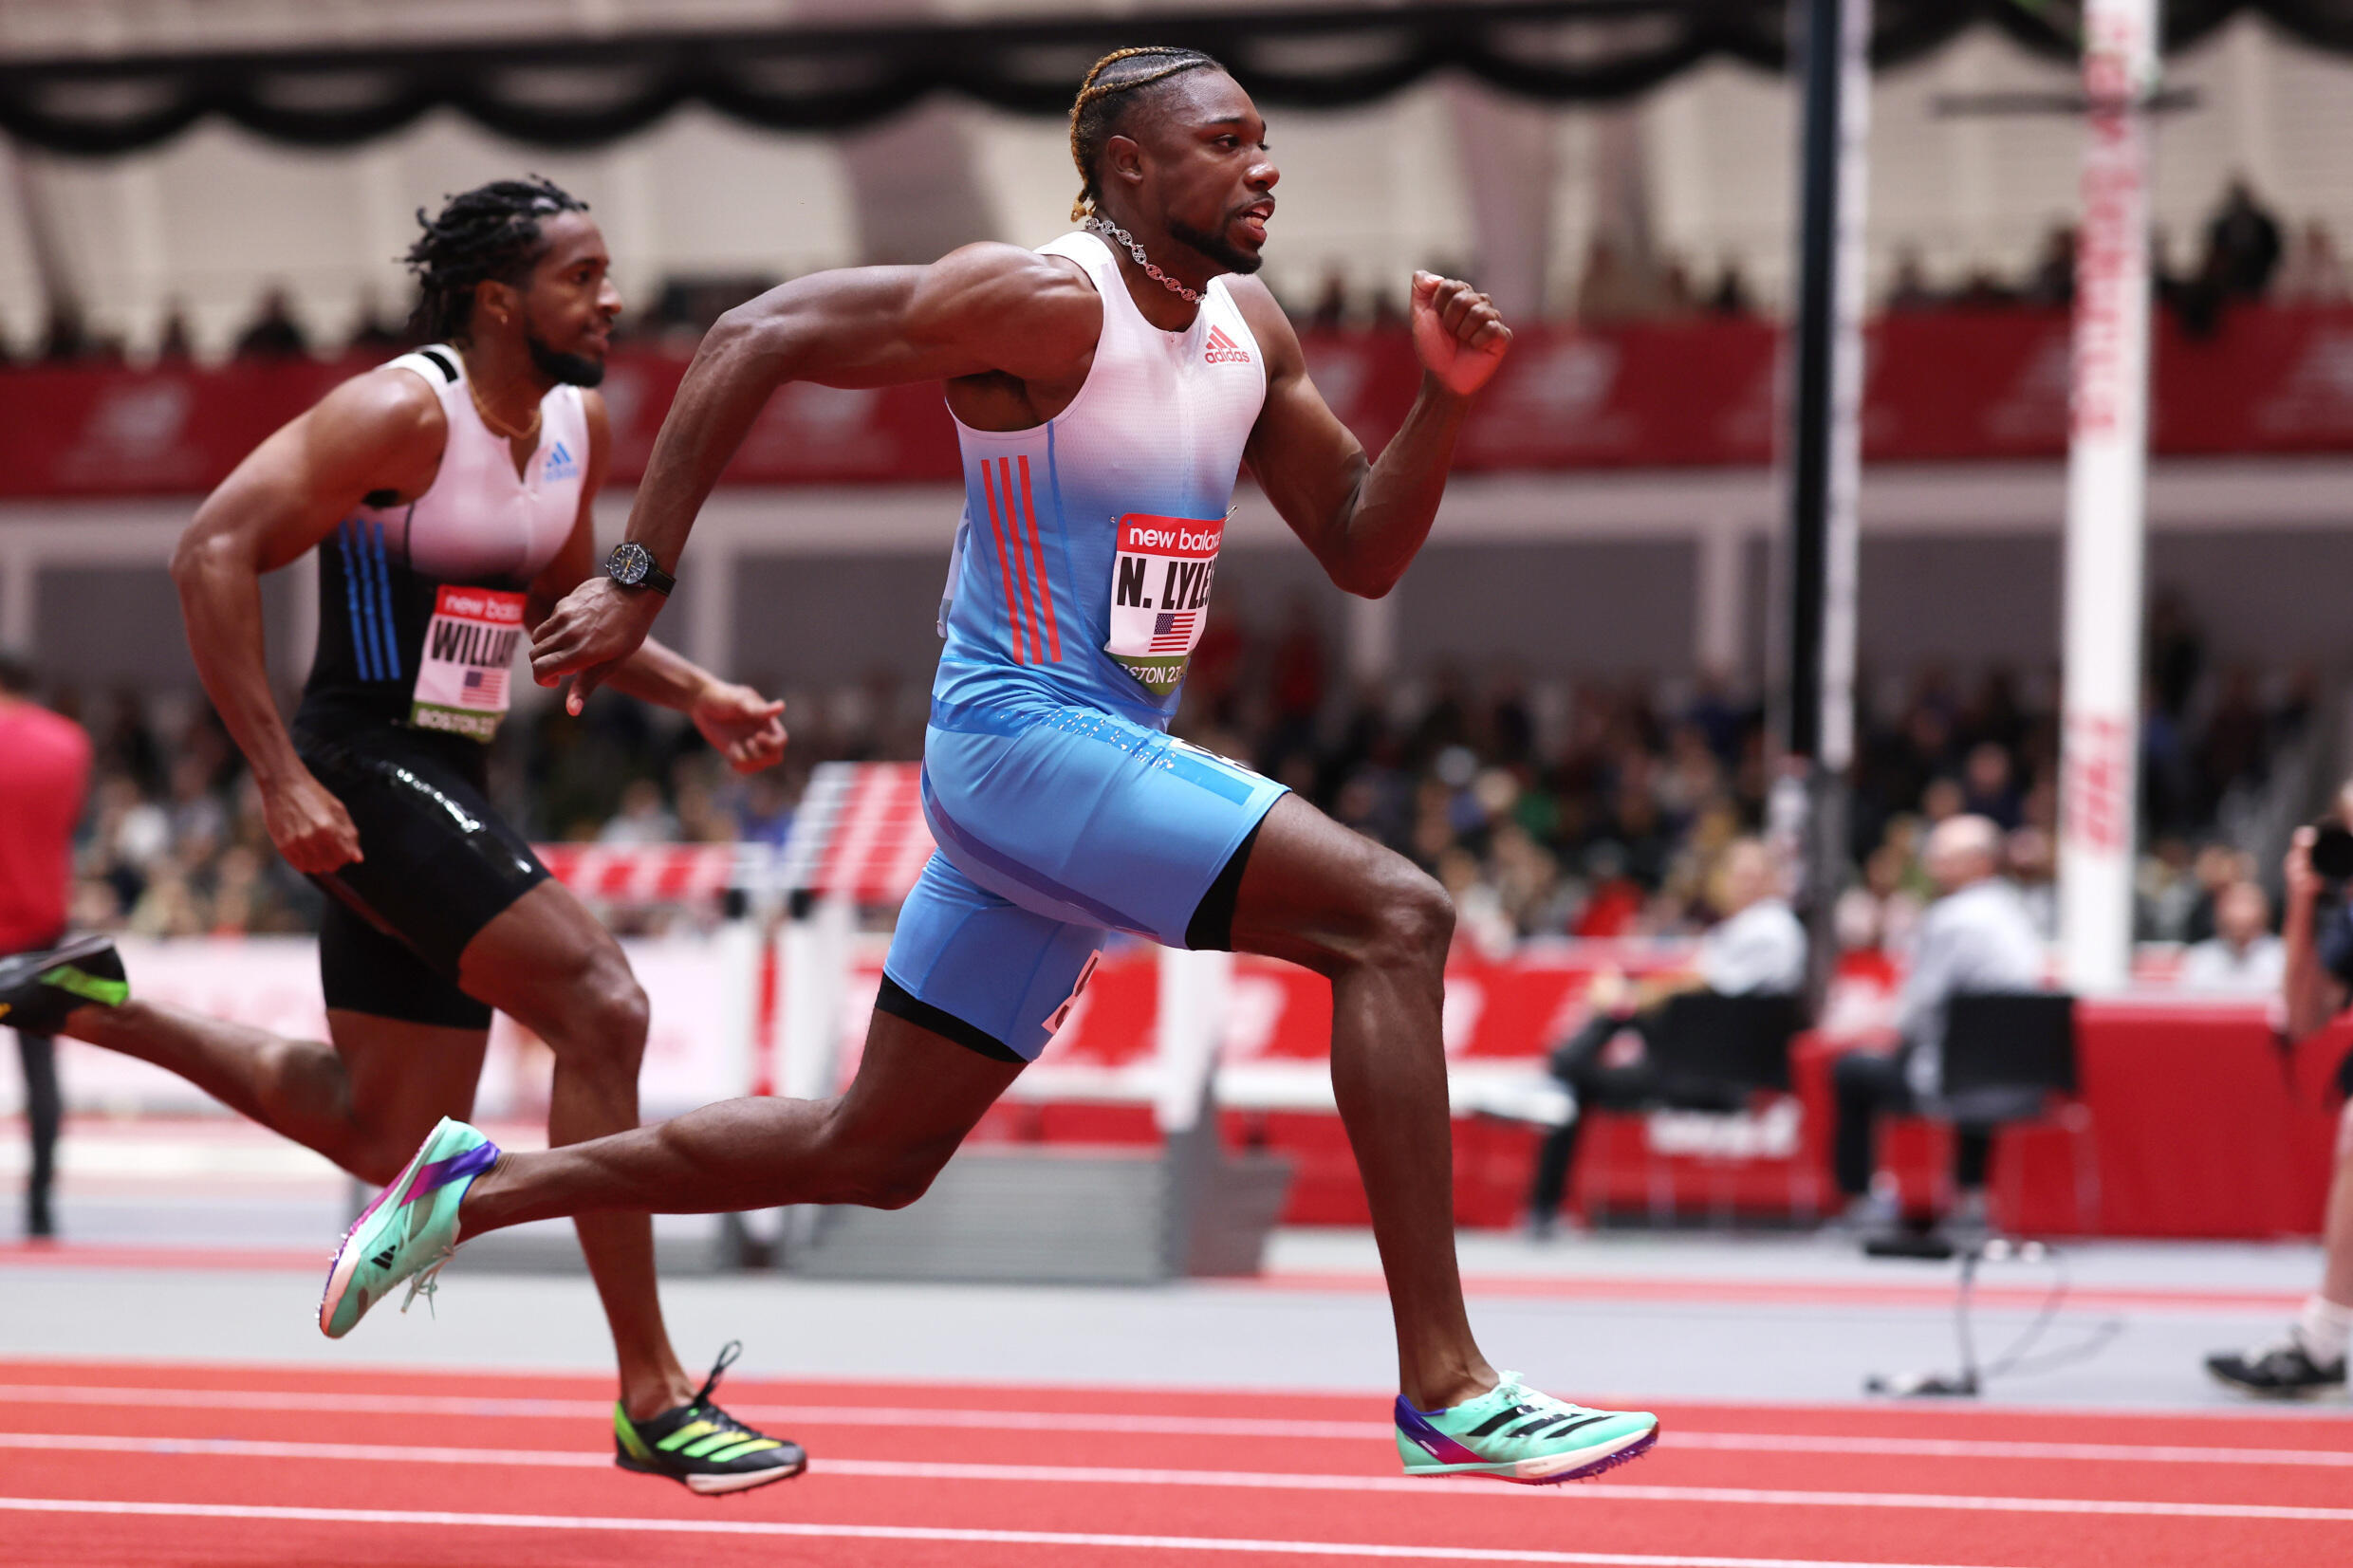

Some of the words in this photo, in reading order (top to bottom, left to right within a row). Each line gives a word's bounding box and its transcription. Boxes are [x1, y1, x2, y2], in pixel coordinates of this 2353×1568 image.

[1205, 348, 1251, 363] adidas
[1129, 527, 1176, 547] new
[1178, 527, 1221, 550] bala
[1117, 557, 1152, 608] N.
[445, 596, 484, 616] new
[431, 619, 521, 669] WILLIA
[1120, 663, 1166, 684] STON
